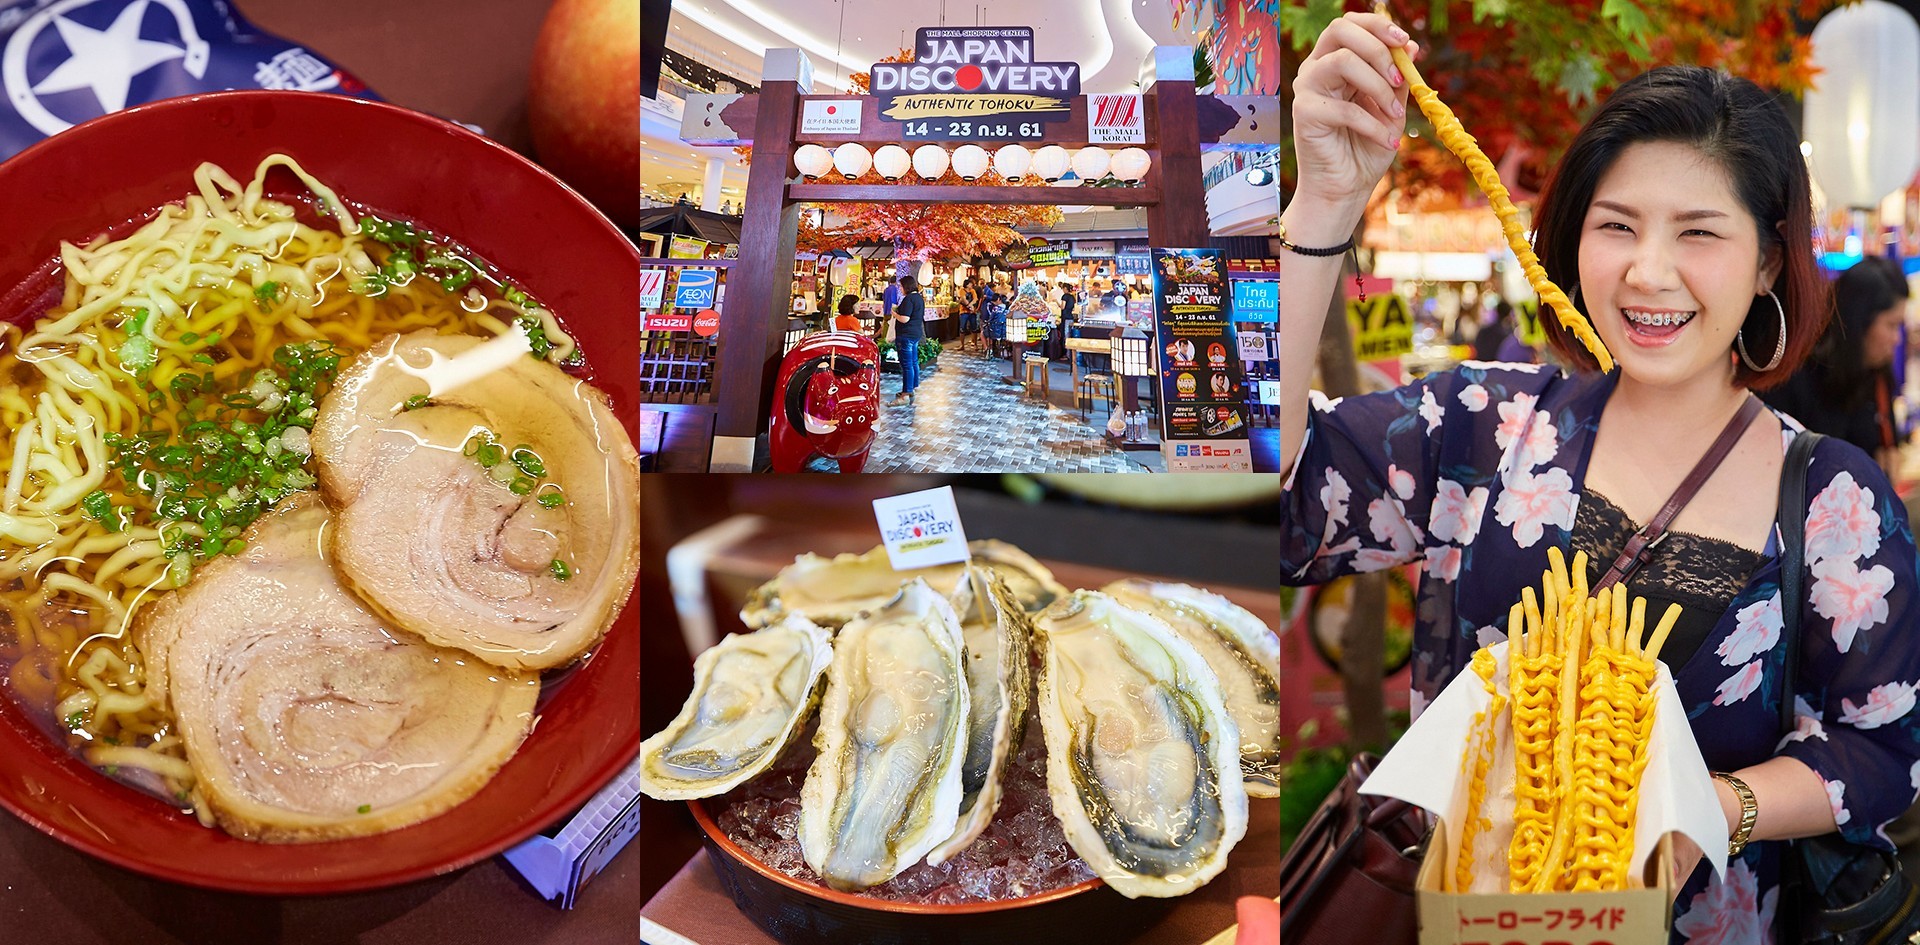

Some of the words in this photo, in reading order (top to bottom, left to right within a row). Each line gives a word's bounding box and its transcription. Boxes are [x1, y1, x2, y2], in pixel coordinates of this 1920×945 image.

[919, 40, 1029, 63] JAPAN
[874, 66, 1075, 90] DISCOVERY
[904, 98, 975, 110] AUTHENTIC
[979, 99, 1034, 110] TOHOKU
[905, 122, 929, 136] 14
[948, 122, 972, 136] 23
[978, 124, 1013, 137] ก.ย.
[1019, 123, 1042, 137] 61
[1177, 287, 1209, 296] JAPAN
[1242, 285, 1267, 297] ไทย
[1165, 296, 1221, 304] DISCOVERY
[649, 319, 688, 327] ISUZU
[898, 508, 935, 527] JAPAN
[886, 520, 954, 541] DISCOVERY
